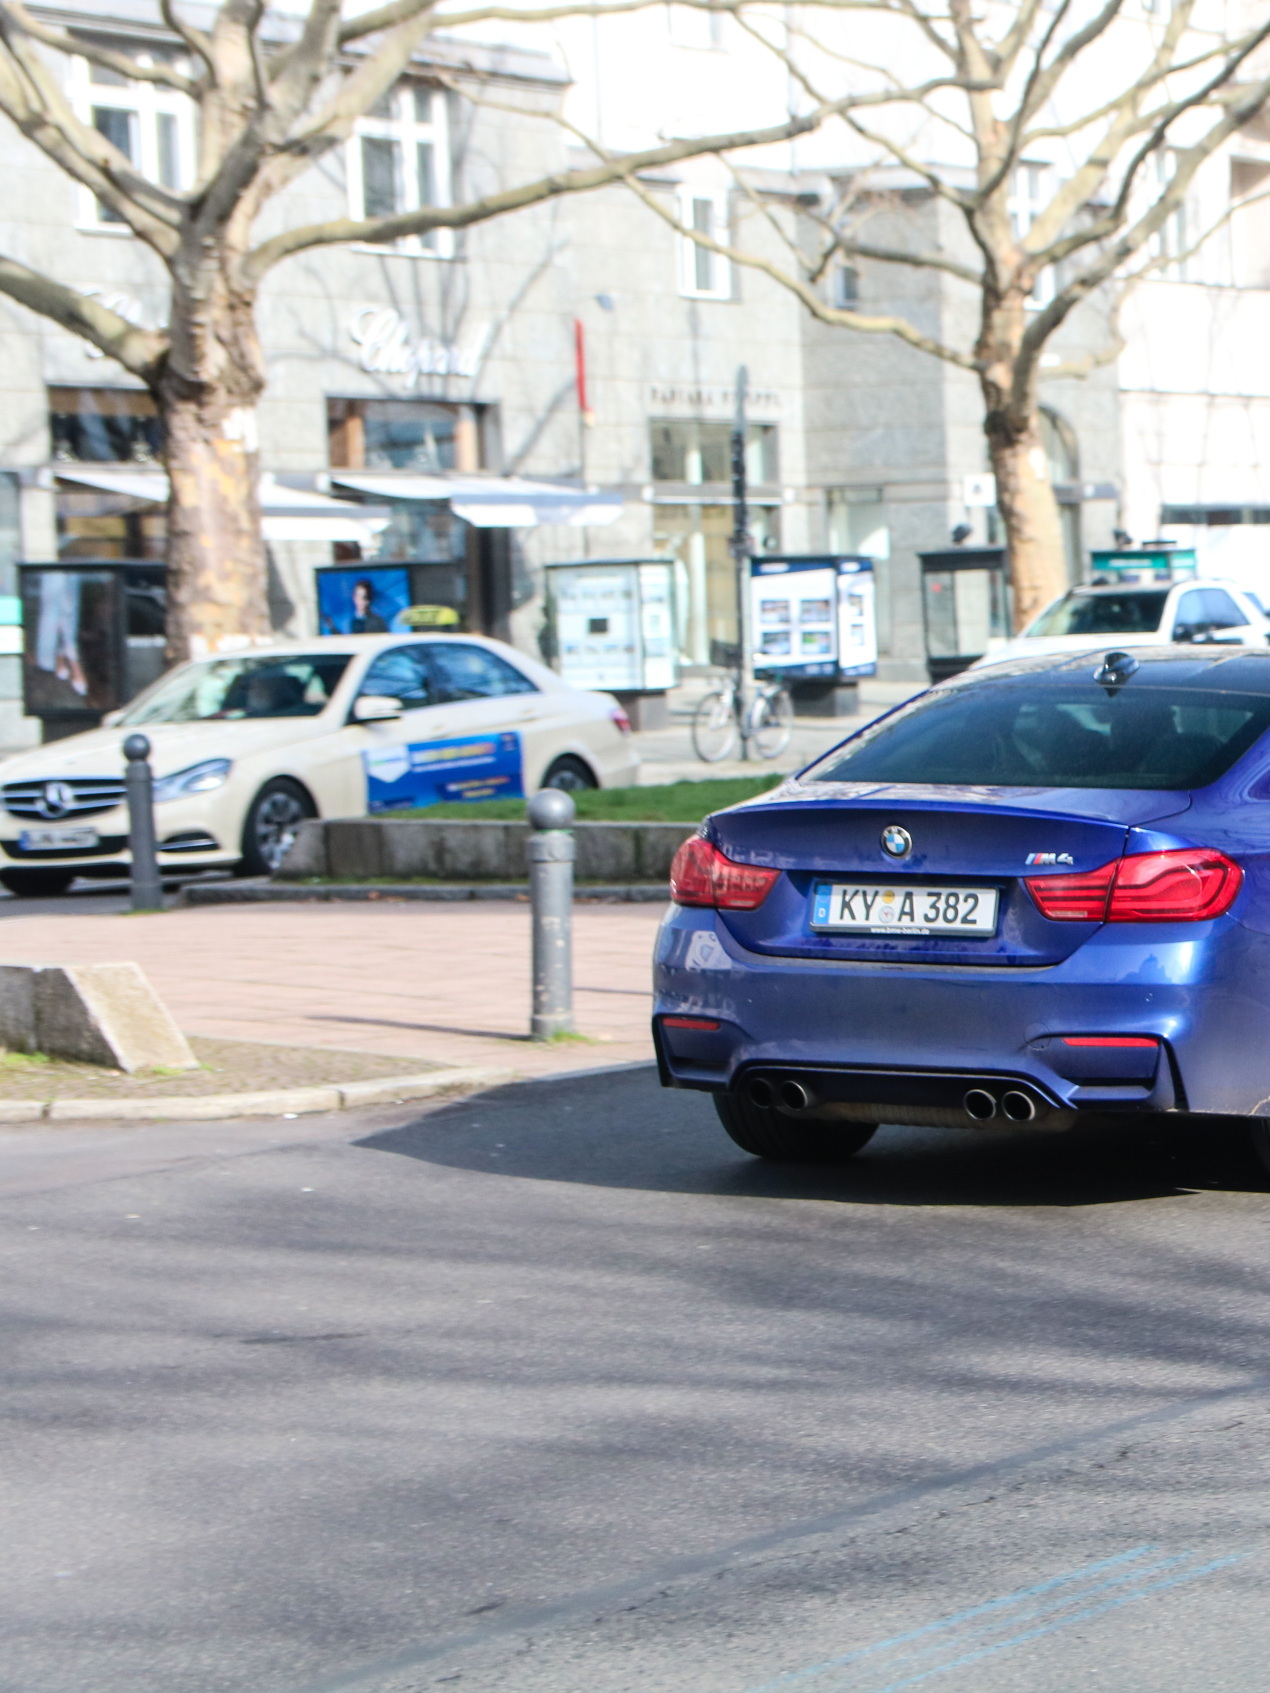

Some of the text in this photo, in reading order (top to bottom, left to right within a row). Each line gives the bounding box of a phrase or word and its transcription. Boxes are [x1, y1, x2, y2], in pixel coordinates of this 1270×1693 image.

[839, 888, 980, 925] KY A 382
